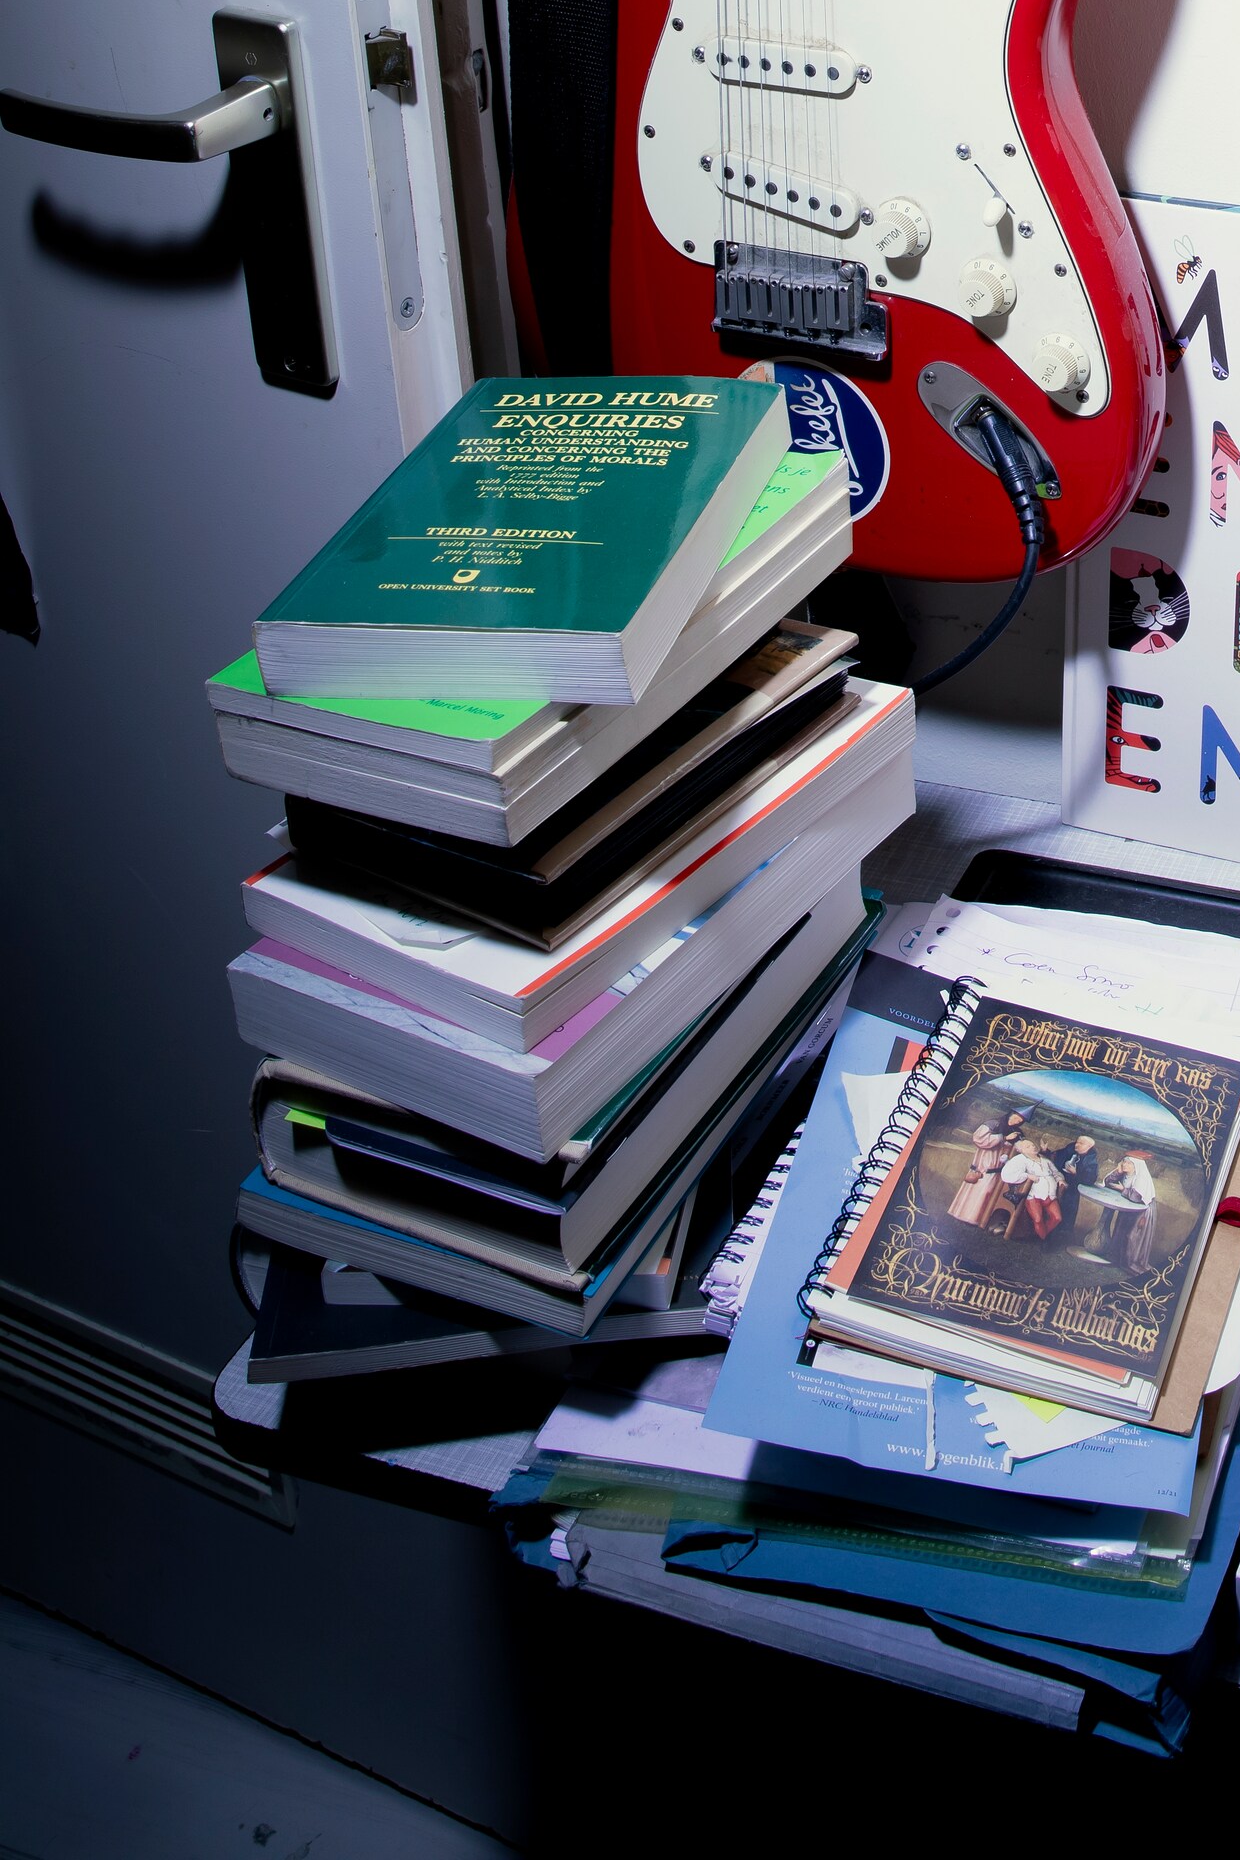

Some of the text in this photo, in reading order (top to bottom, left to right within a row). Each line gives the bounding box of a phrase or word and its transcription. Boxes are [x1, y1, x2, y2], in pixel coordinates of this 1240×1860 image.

[877, 228, 903, 252] VOLUME
[965, 291, 986, 308] TONE
[1041, 362, 1058, 384] TONE
[494, 392, 720, 410] DAVID HUME
[492, 413, 686, 431] ENQUIRIES
[519, 428, 639, 438] CONCERNING
[457, 437, 690, 450] HUMAN UNDERSTANDING
[460, 446, 673, 458] AND CONCERNING THE
[450, 454, 669, 467] PRINCIPLES OF MORALS
[496, 464, 554, 473] Reprinted
[557, 464, 583, 474] from
[538, 471, 580, 480] edition
[474, 484, 536, 495] Analytical
[537, 485, 576, 494] Index
[504, 478, 606, 488] Introduction and
[509, 492, 580, 502] Selby-Bigge
[425, 527, 578, 540] THIRD EDITION
[438, 540, 544, 551] with text revised
[443, 549, 471, 557] and
[473, 550, 504, 558] notes
[470, 557, 525, 567] Nidditch
[410, 583, 479, 594] UNIVERSITY
[479, 586, 501, 594] SET
[502, 586, 537, 596] BOOK
[795, 1016, 834, 1064] VAN GORCUM
[824, 1379, 837, 1387] en
[796, 1383, 878, 1410] verdient een groot
[818, 1397, 900, 1423] NRC Handelsblad
[1079, 1441, 1115, 1454] Journal
[1157, 1489, 1178, 1498] 12/21
